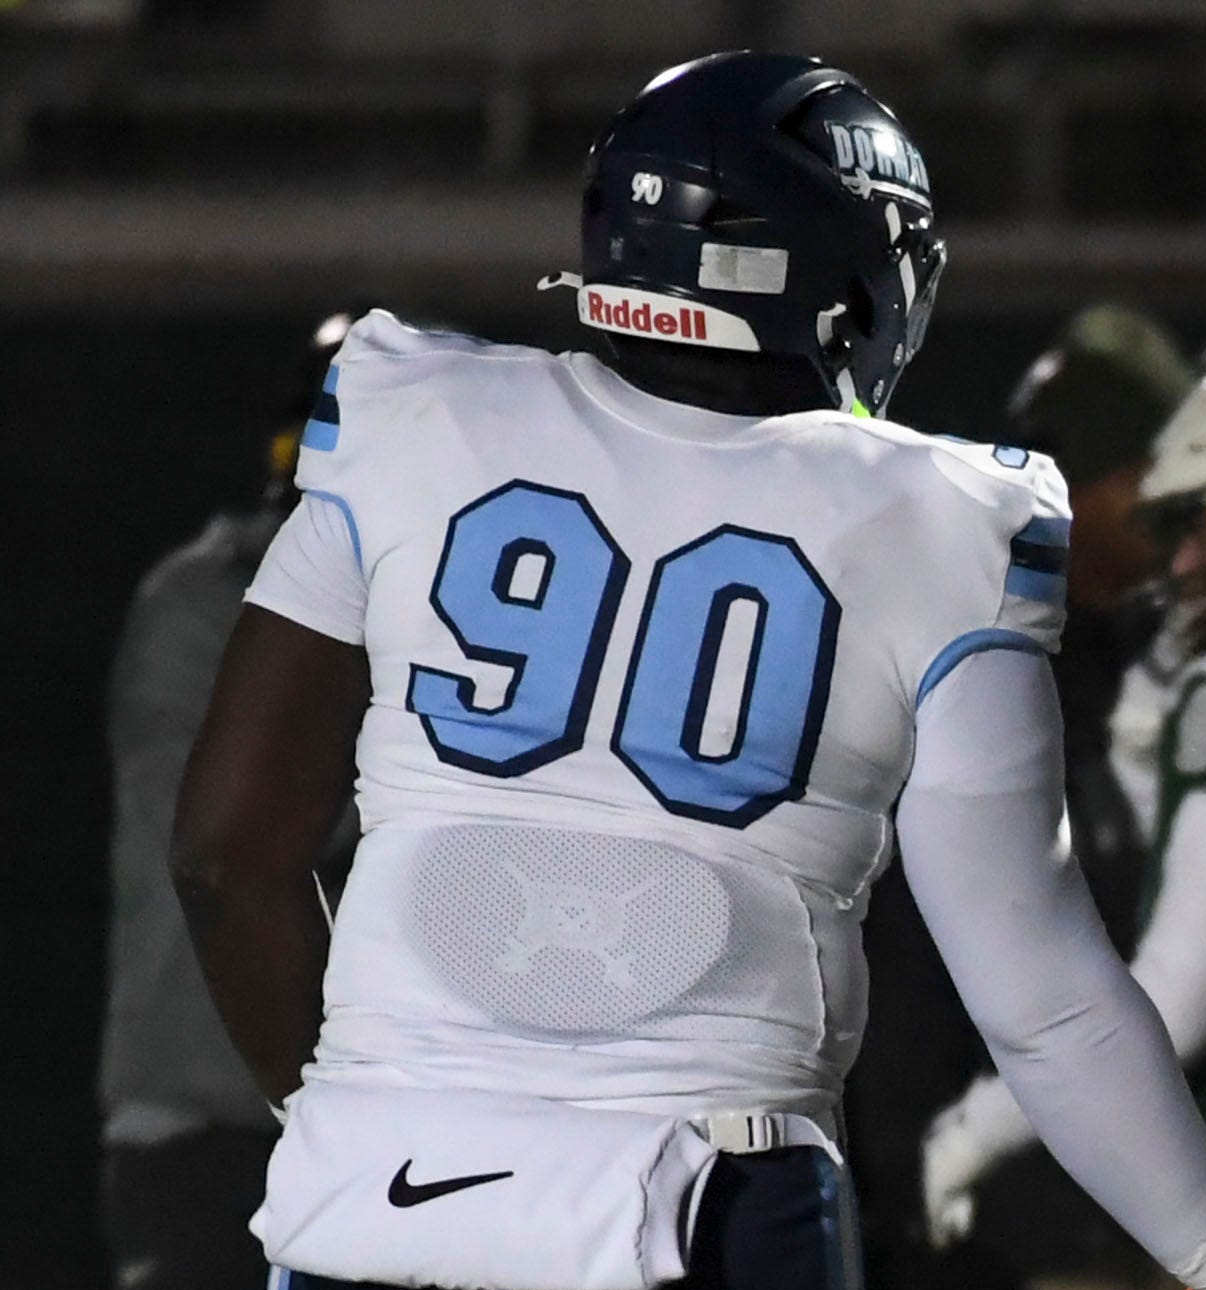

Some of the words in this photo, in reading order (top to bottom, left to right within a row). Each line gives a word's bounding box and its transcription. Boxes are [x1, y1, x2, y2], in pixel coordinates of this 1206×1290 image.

[631, 172, 663, 205] 90
[588, 292, 707, 341] Riddell
[405, 478, 843, 830] 90
